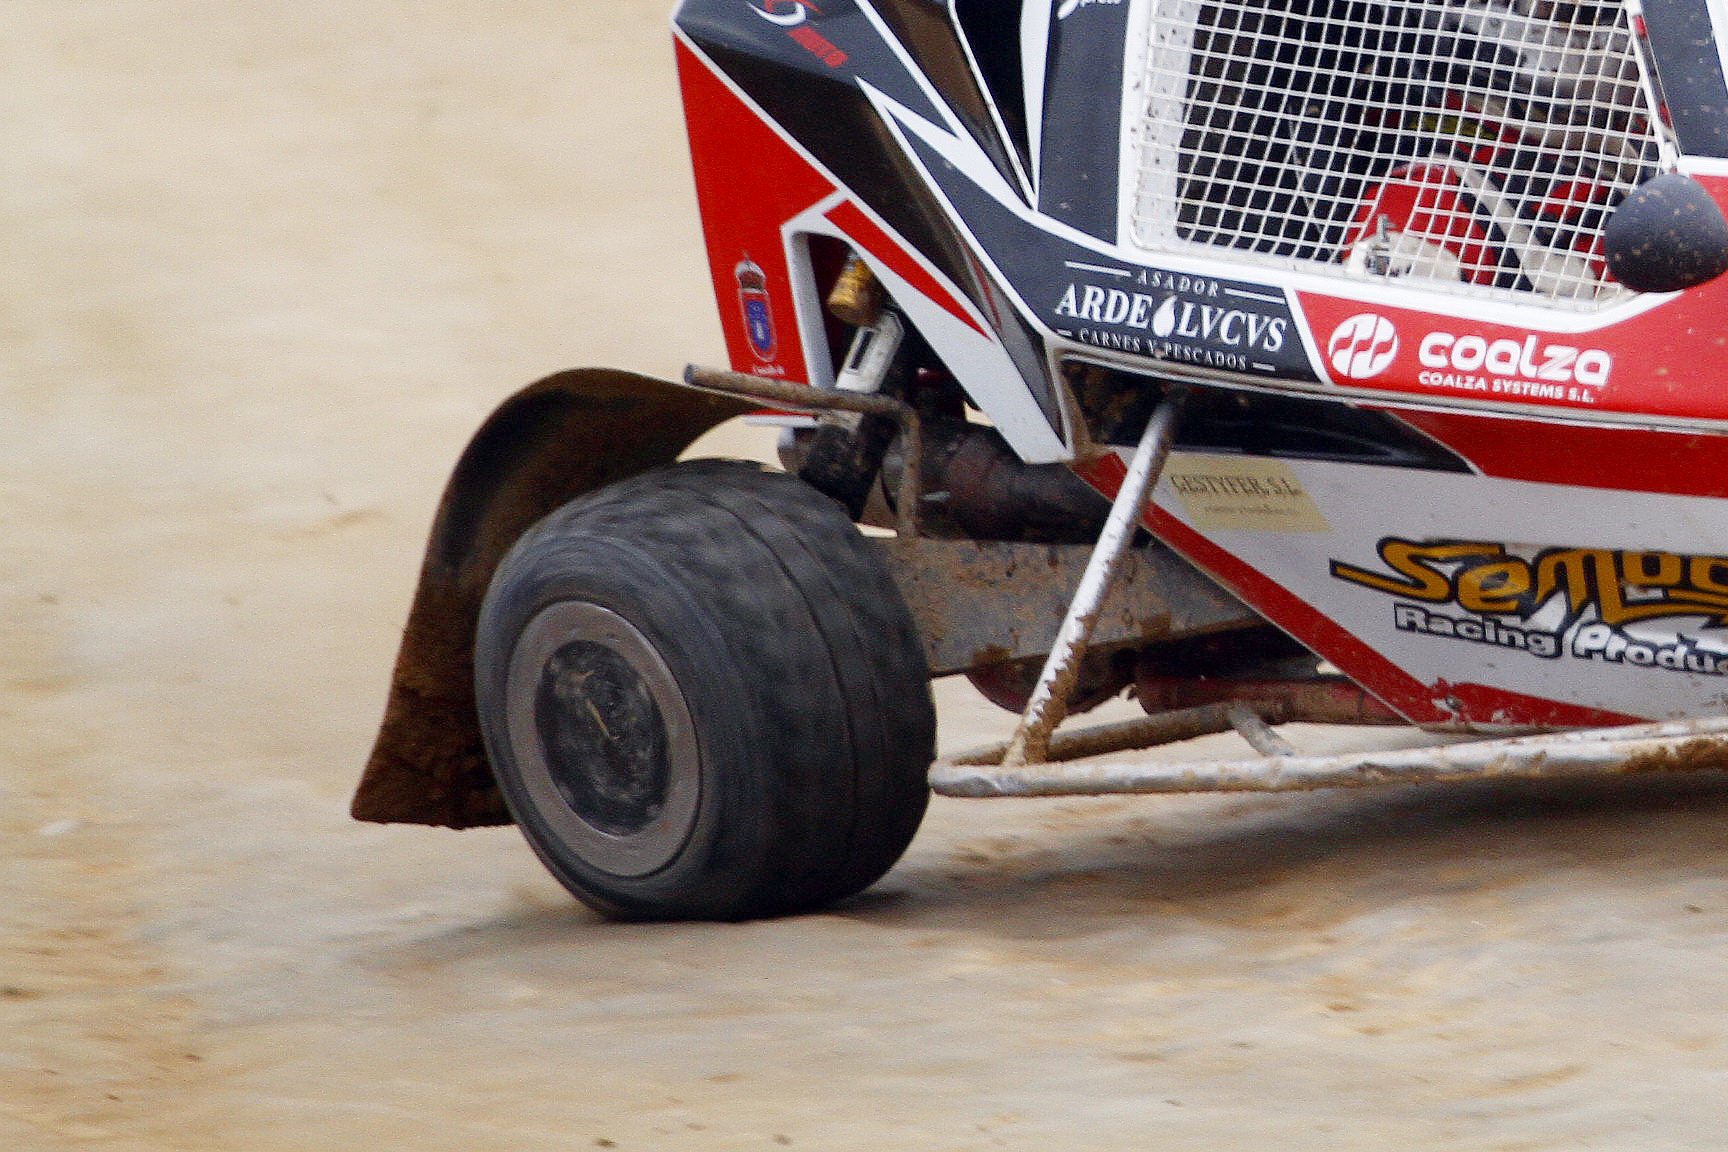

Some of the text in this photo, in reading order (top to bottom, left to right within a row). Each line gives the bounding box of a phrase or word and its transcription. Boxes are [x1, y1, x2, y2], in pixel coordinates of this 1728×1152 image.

[1137, 269, 1219, 297] ASADOR
[1054, 282, 1153, 330] ARDE
[1079, 327, 1141, 353] CARNES
[1163, 343, 1247, 371] PESCADOS
[1418, 371, 1488, 392] COALZA
[1491, 378, 1564, 400] SYSTEMS
[1394, 602, 1562, 659] Racing
